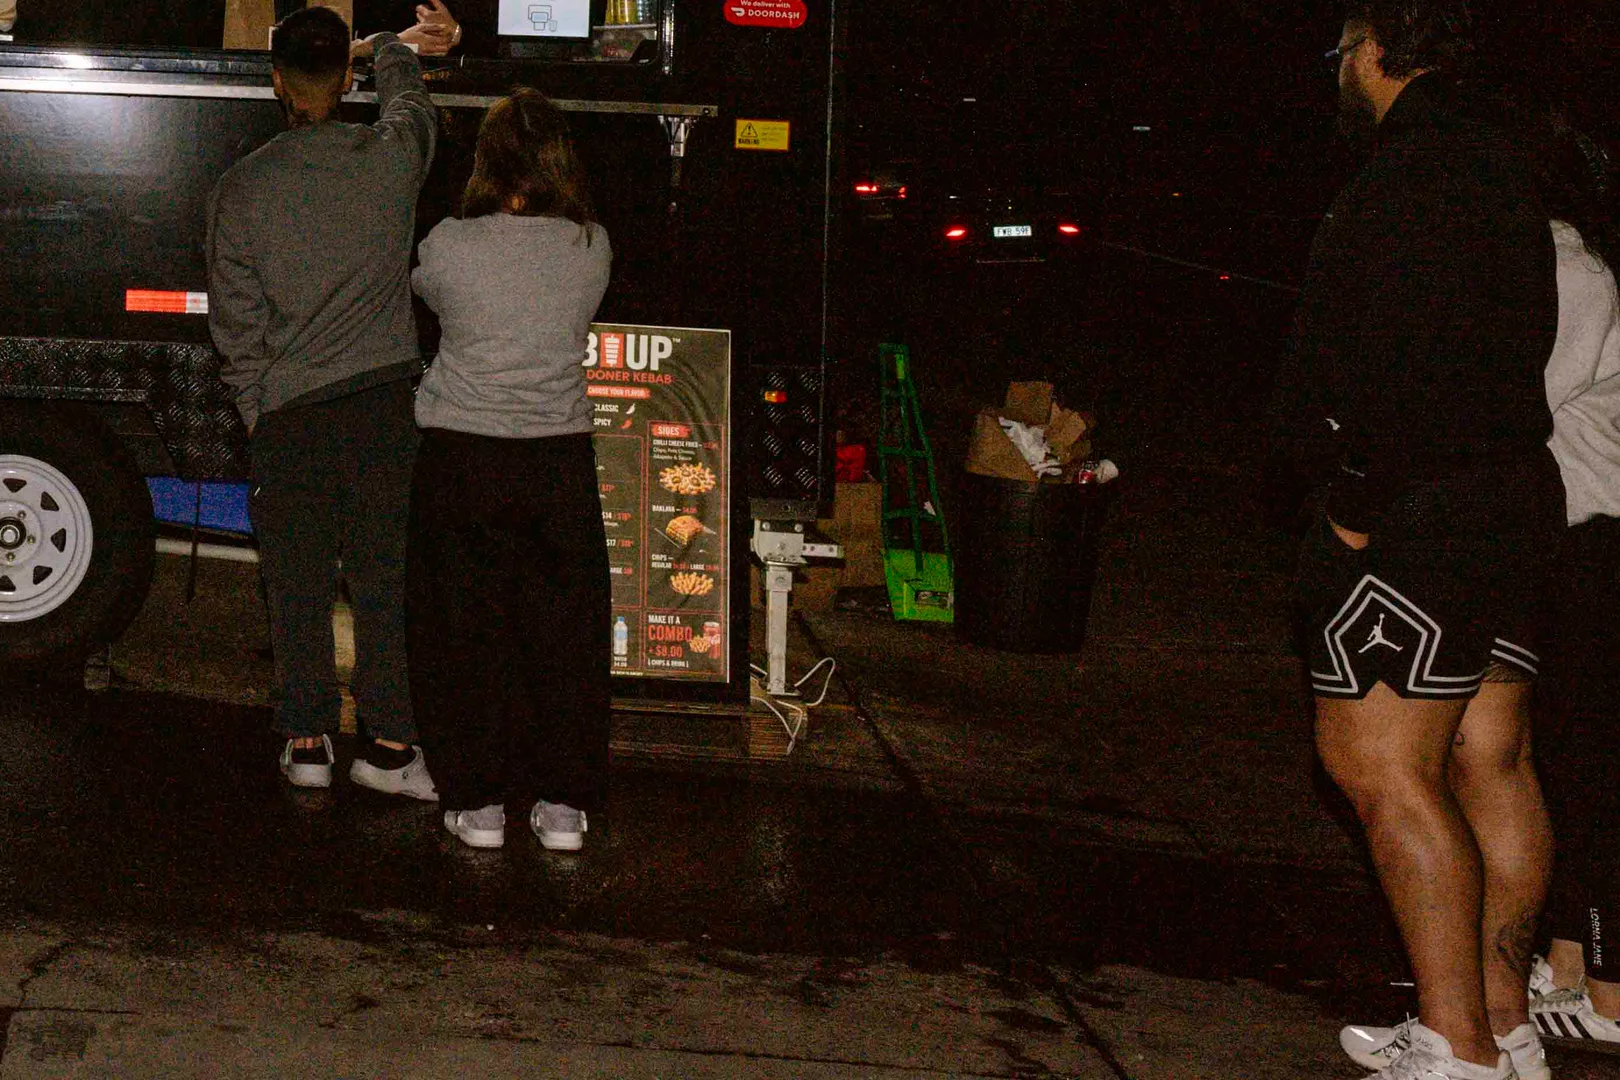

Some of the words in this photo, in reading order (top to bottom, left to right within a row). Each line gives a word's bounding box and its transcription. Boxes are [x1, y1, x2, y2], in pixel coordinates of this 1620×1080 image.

[753, 0, 775, 8] deliver
[748, 9, 800, 20] DOORDASH
[626, 333, 673, 371] UP
[586, 369, 629, 382] DONER
[633, 372, 672, 385] KEBAB
[593, 418, 612, 427] SPICY
[658, 426, 680, 436] SIDES
[610, 567, 623, 575] ARGE
[648, 614, 667, 624] MAKE
[668, 615, 674, 625] IT
[675, 616, 681, 625] A
[648, 624, 693, 642] COMBO
[1590, 907, 1601, 940] LORNA
[1592, 941, 1602, 967] JANE
